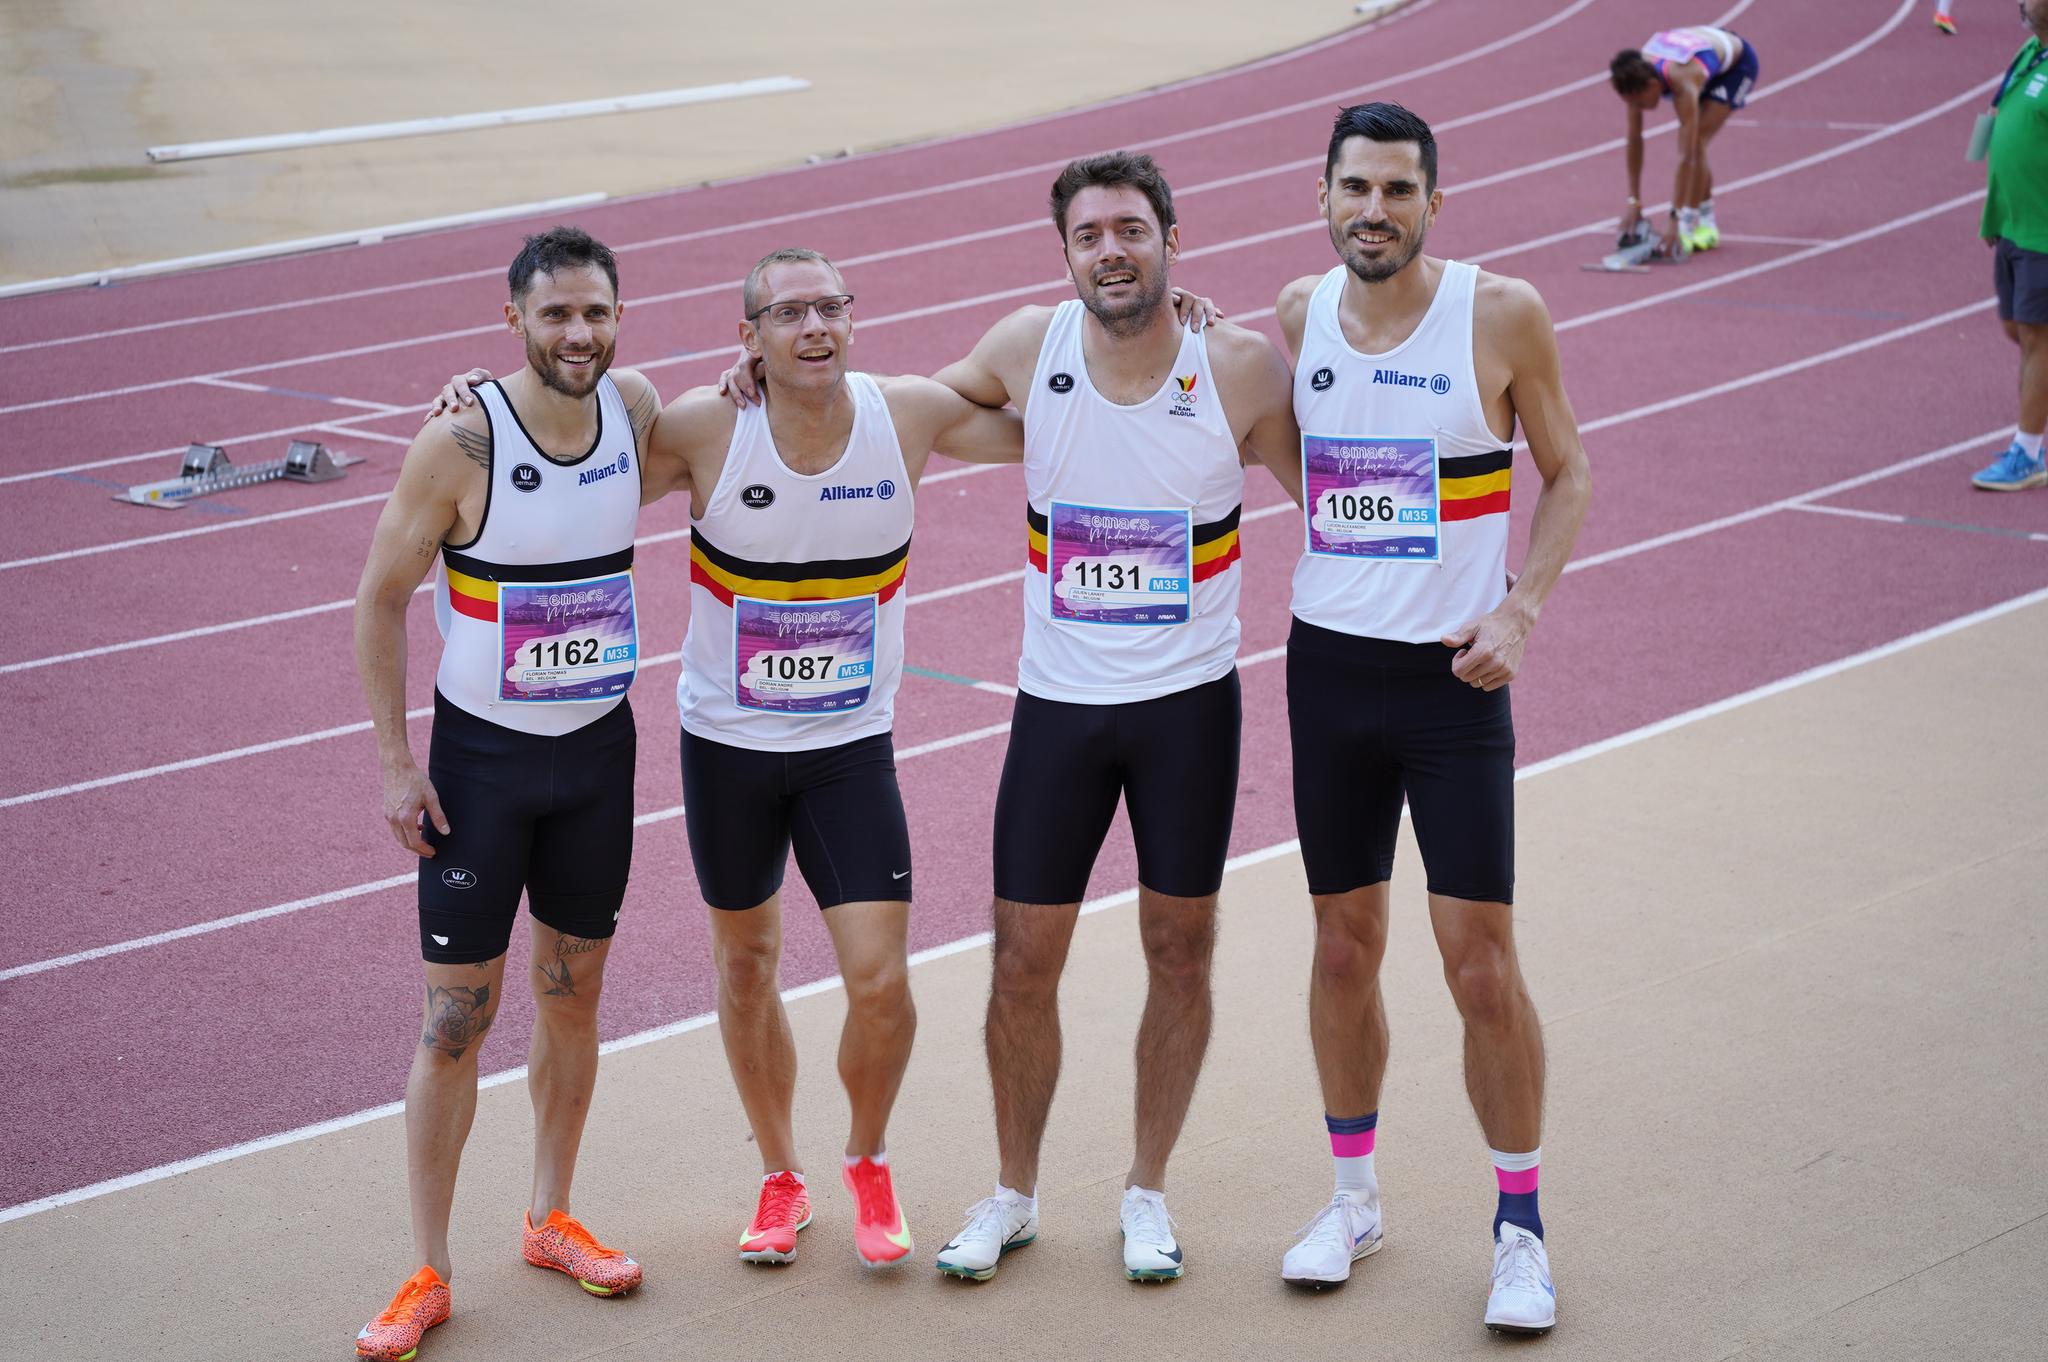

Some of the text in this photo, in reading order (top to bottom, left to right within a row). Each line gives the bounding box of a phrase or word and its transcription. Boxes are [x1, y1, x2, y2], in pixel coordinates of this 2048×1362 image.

[1373, 370, 1426, 388] Allianz
[578, 463, 617, 486] Allianz
[820, 486, 874, 501] Allianz
[1327, 494, 1428, 521] 1086 M35
[1075, 562, 1179, 590] 1131 M35
[548, 588, 605, 607] emacs
[780, 610, 841, 624] emacs
[530, 638, 629, 668] 1162 M35
[761, 655, 865, 680] 1087 M35
